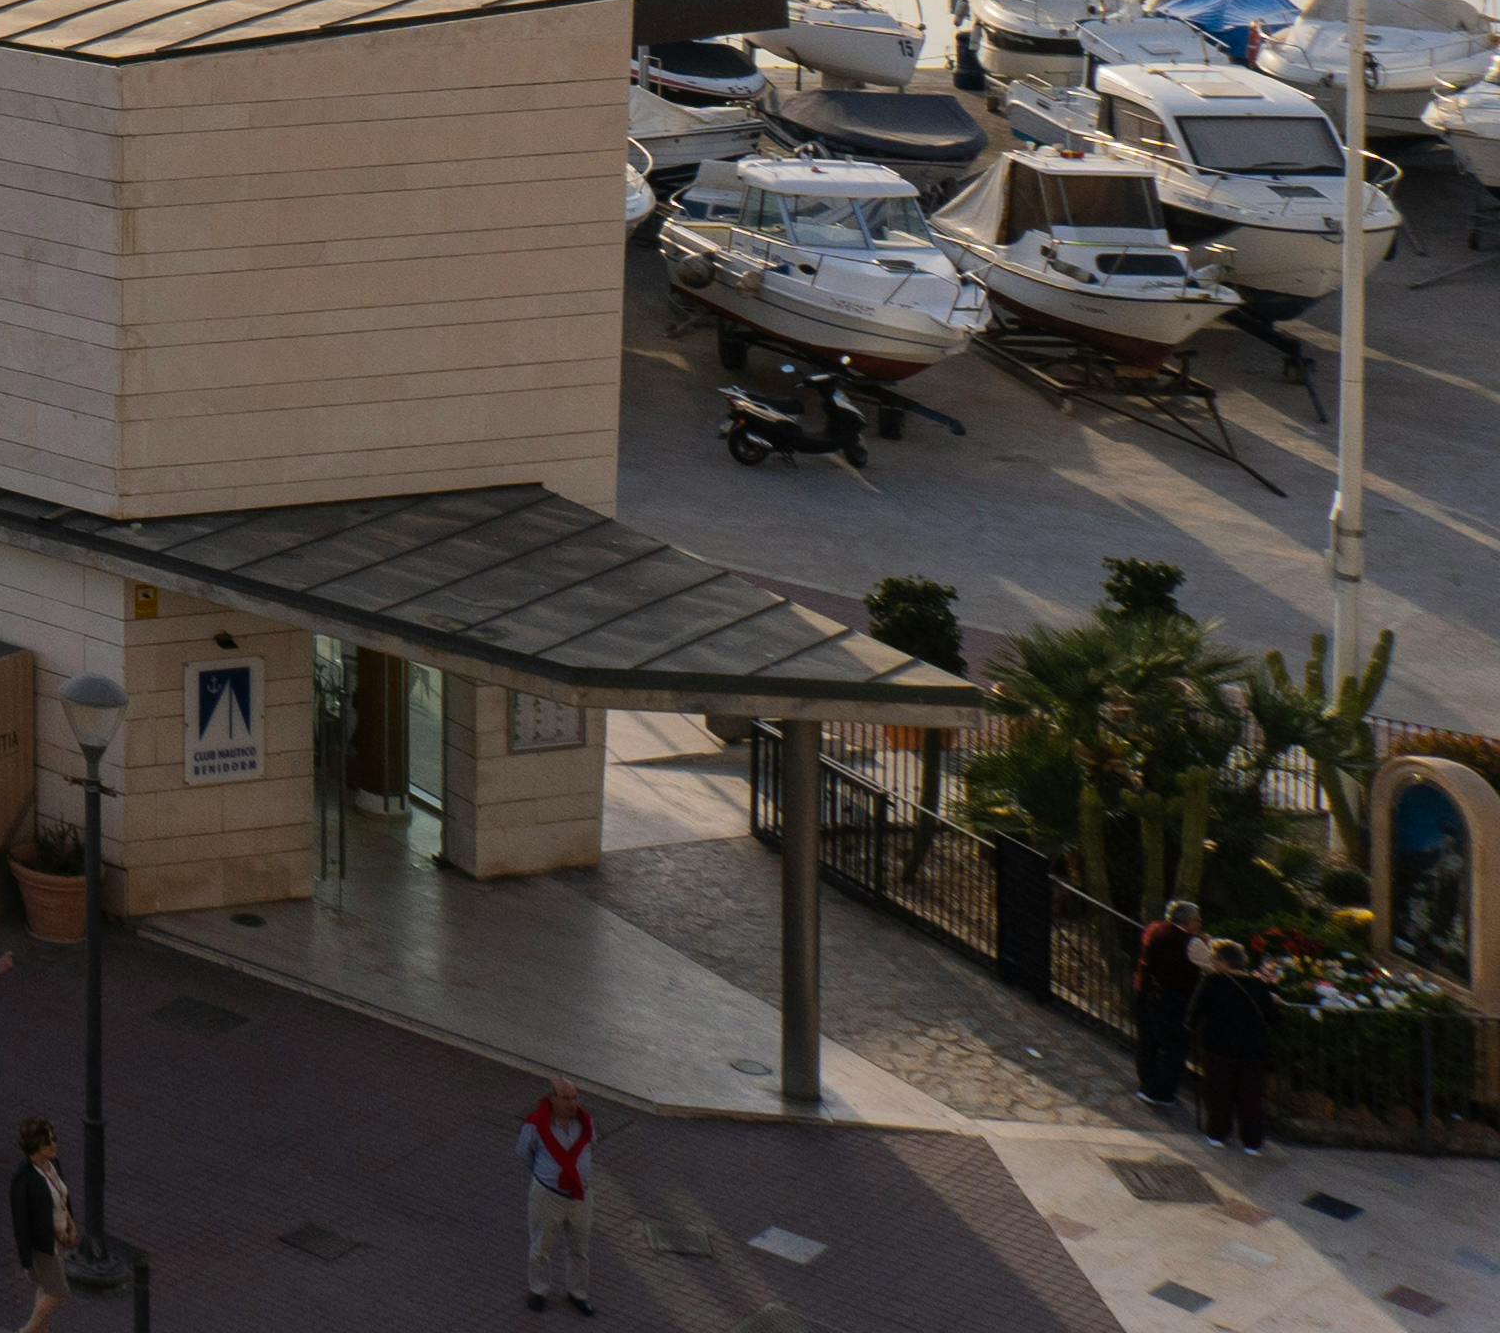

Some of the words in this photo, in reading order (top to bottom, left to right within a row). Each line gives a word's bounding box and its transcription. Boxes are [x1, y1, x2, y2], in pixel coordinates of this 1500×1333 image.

[898, 40, 914, 58] 15
[193, 749, 216, 762] CLUB
[217, 746, 257, 759] NAUTICO
[193, 760, 258, 775] BENIDORM
